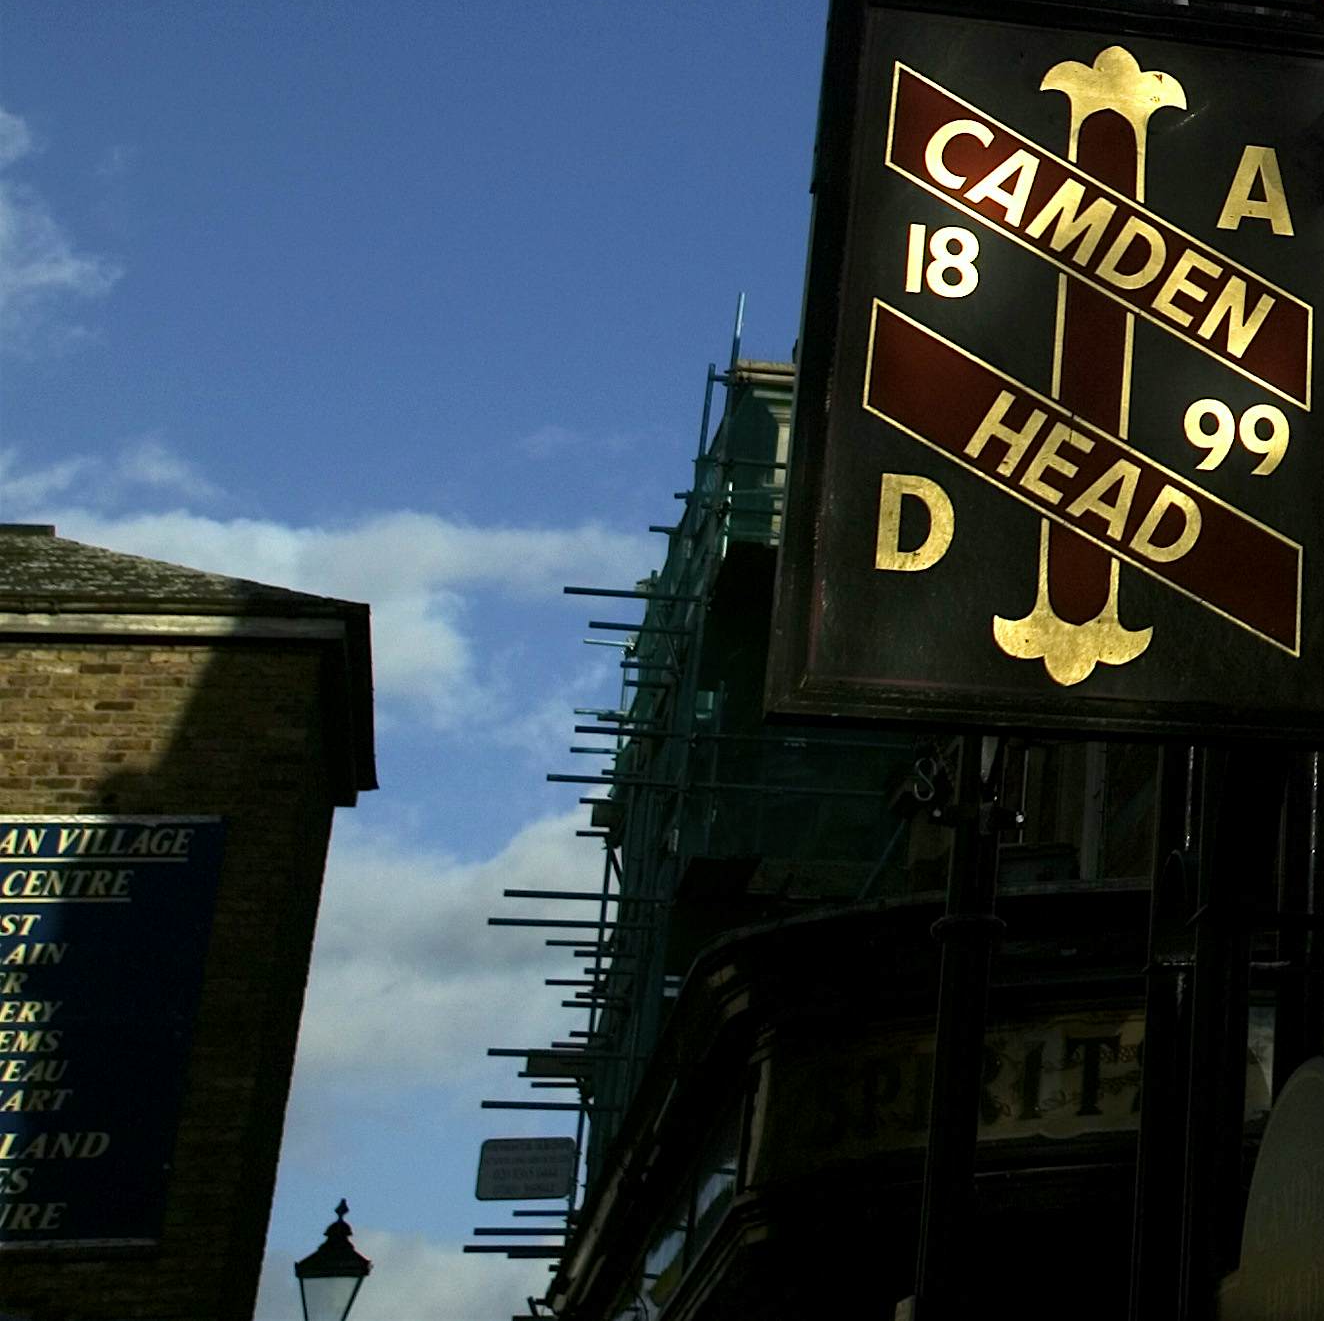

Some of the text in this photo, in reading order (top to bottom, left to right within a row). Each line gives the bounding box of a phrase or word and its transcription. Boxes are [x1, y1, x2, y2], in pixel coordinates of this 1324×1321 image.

[1215, 144, 1296, 237] A
[904, 222, 981, 299] 18
[923, 118, 1278, 360] CAMDEN
[1182, 397, 1292, 477] 99
[963, 388, 1204, 564] HEAD
[873, 473, 957, 572] D
[0, 828, 196, 855] AN VILLAGE
[2, 869, 135, 897] CENTRE
[0, 942, 70, 965] AIN
[0, 1059, 70, 1082] EAU
[0, 1089, 74, 1112] ART
